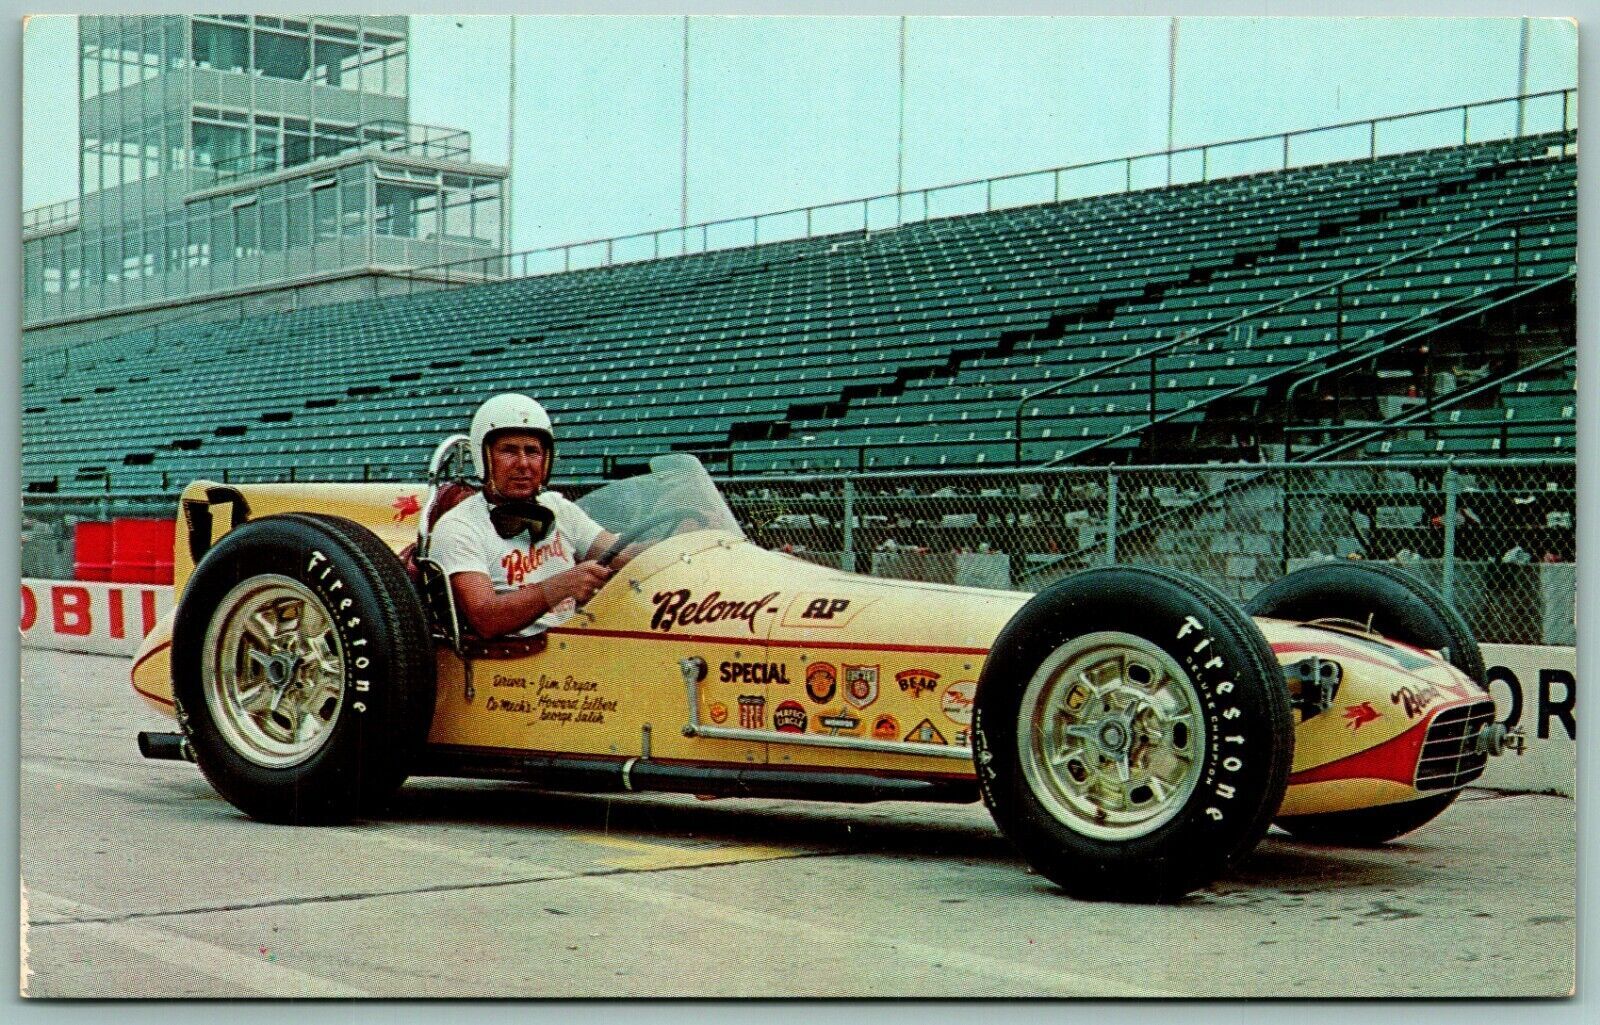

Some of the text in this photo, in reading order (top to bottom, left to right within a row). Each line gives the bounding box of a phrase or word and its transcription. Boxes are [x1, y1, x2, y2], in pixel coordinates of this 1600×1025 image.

[307, 550, 370, 714] Firestone
[719, 661, 791, 685] SPECIAL
[1176, 615, 1246, 822] Firestone
[1206, 715, 1219, 786] CHAMPION
